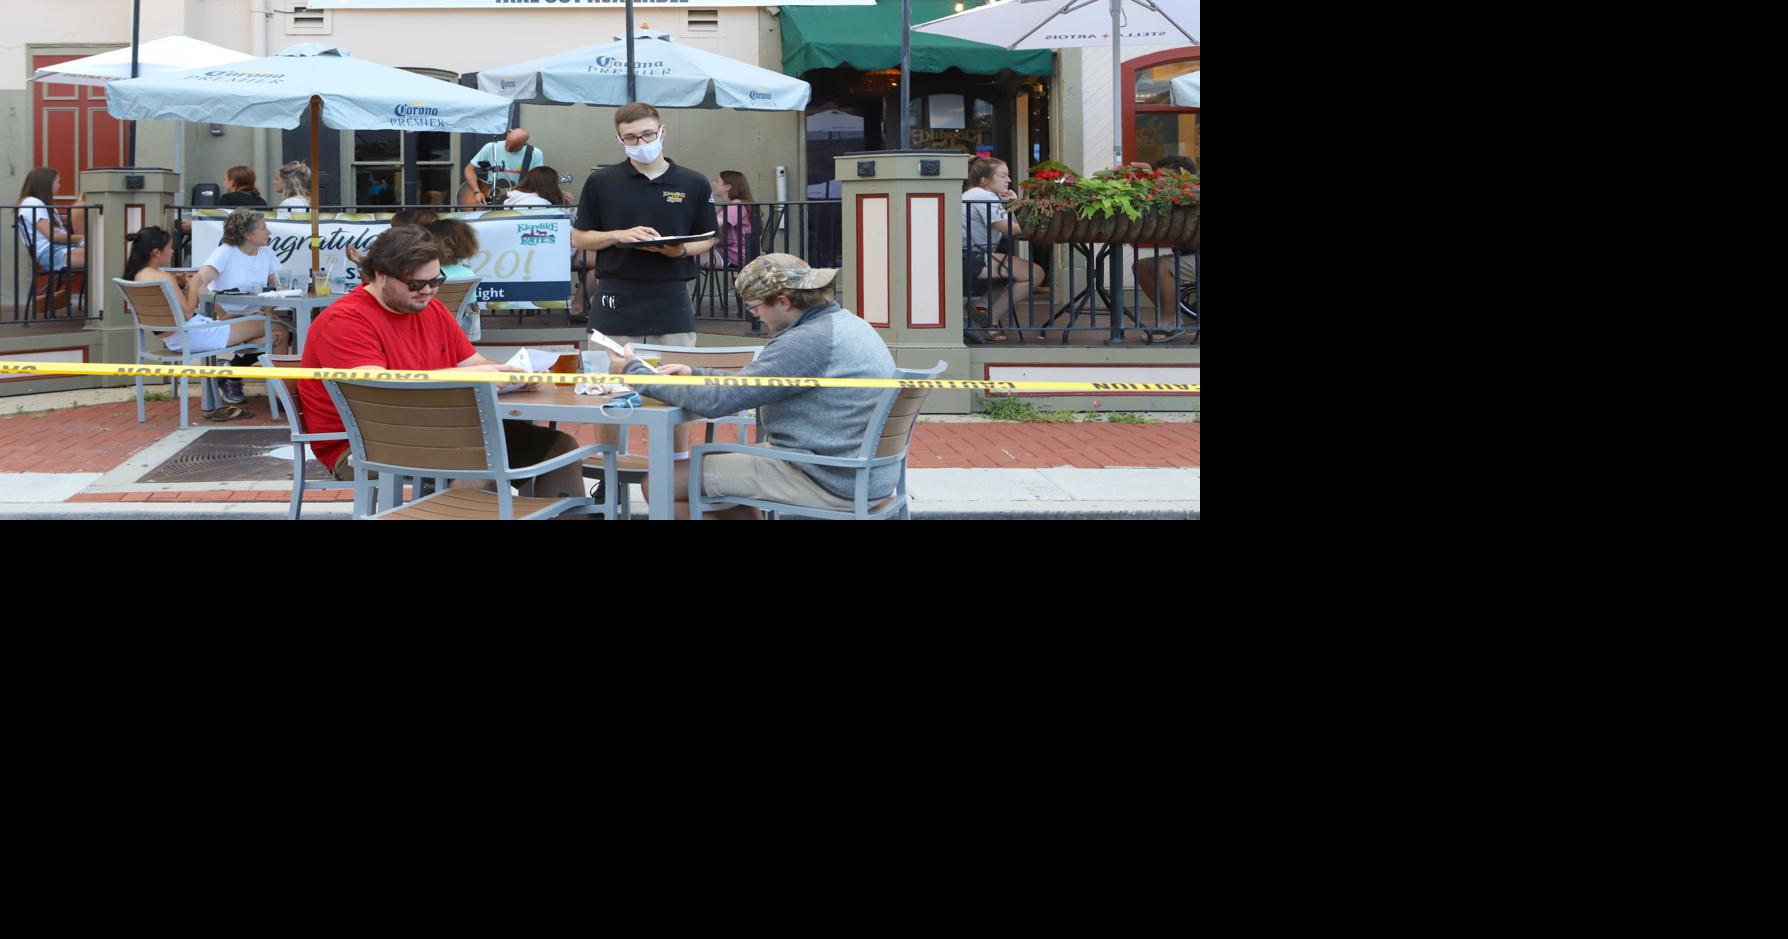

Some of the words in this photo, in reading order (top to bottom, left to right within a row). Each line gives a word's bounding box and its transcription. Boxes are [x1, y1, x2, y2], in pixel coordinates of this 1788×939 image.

[394, 103, 439, 118] Corona
[390, 117, 446, 128] PREMIER
[476, 287, 505, 301] ight
